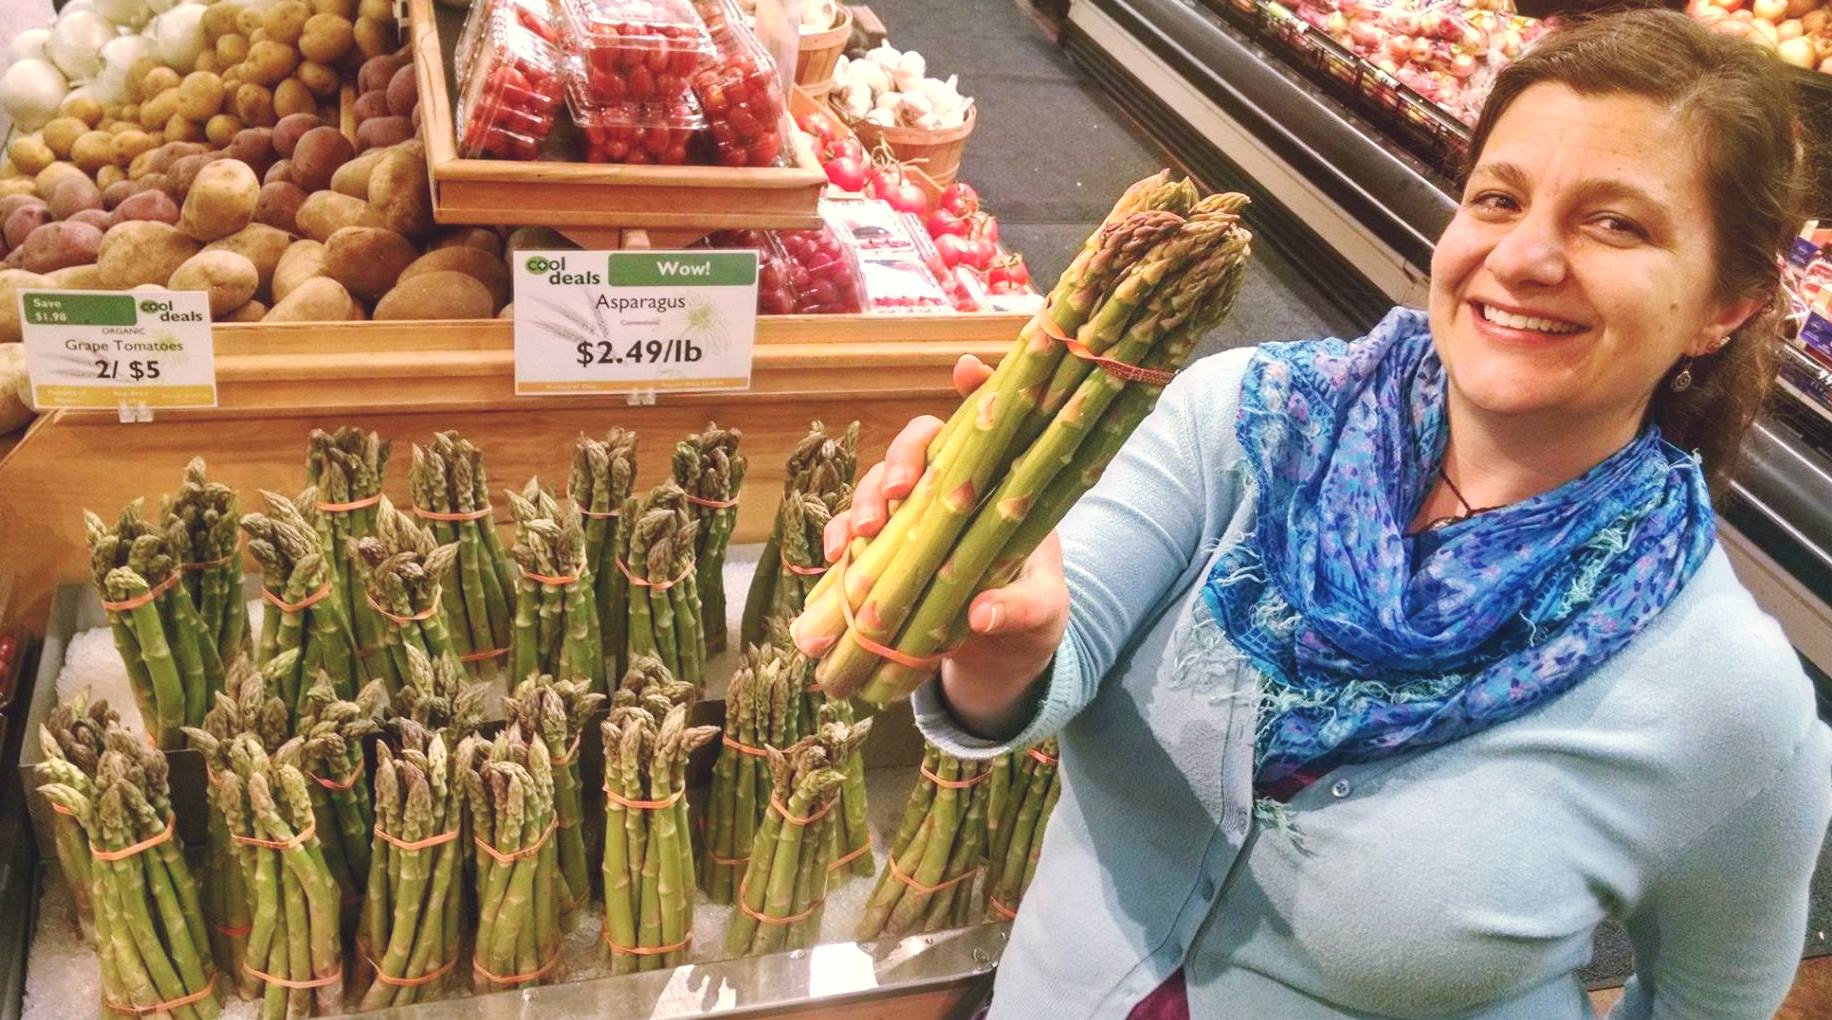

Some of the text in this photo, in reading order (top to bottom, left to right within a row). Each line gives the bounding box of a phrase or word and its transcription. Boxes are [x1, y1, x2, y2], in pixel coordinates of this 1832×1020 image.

[526, 256, 566, 273] cool
[657, 260, 711, 276] Wow!
[549, 271, 600, 285] deals
[32, 298, 62, 308] Save
[140, 300, 173, 313] cool
[595, 293, 686, 313] Asparagus
[160, 311, 203, 322] deals
[101, 327, 146, 335] ORGANIC
[65, 339, 184, 354] Grape Tomatoes
[576, 339, 702, 367] $2.49/lb
[94, 360, 160, 381] 2/ $5
